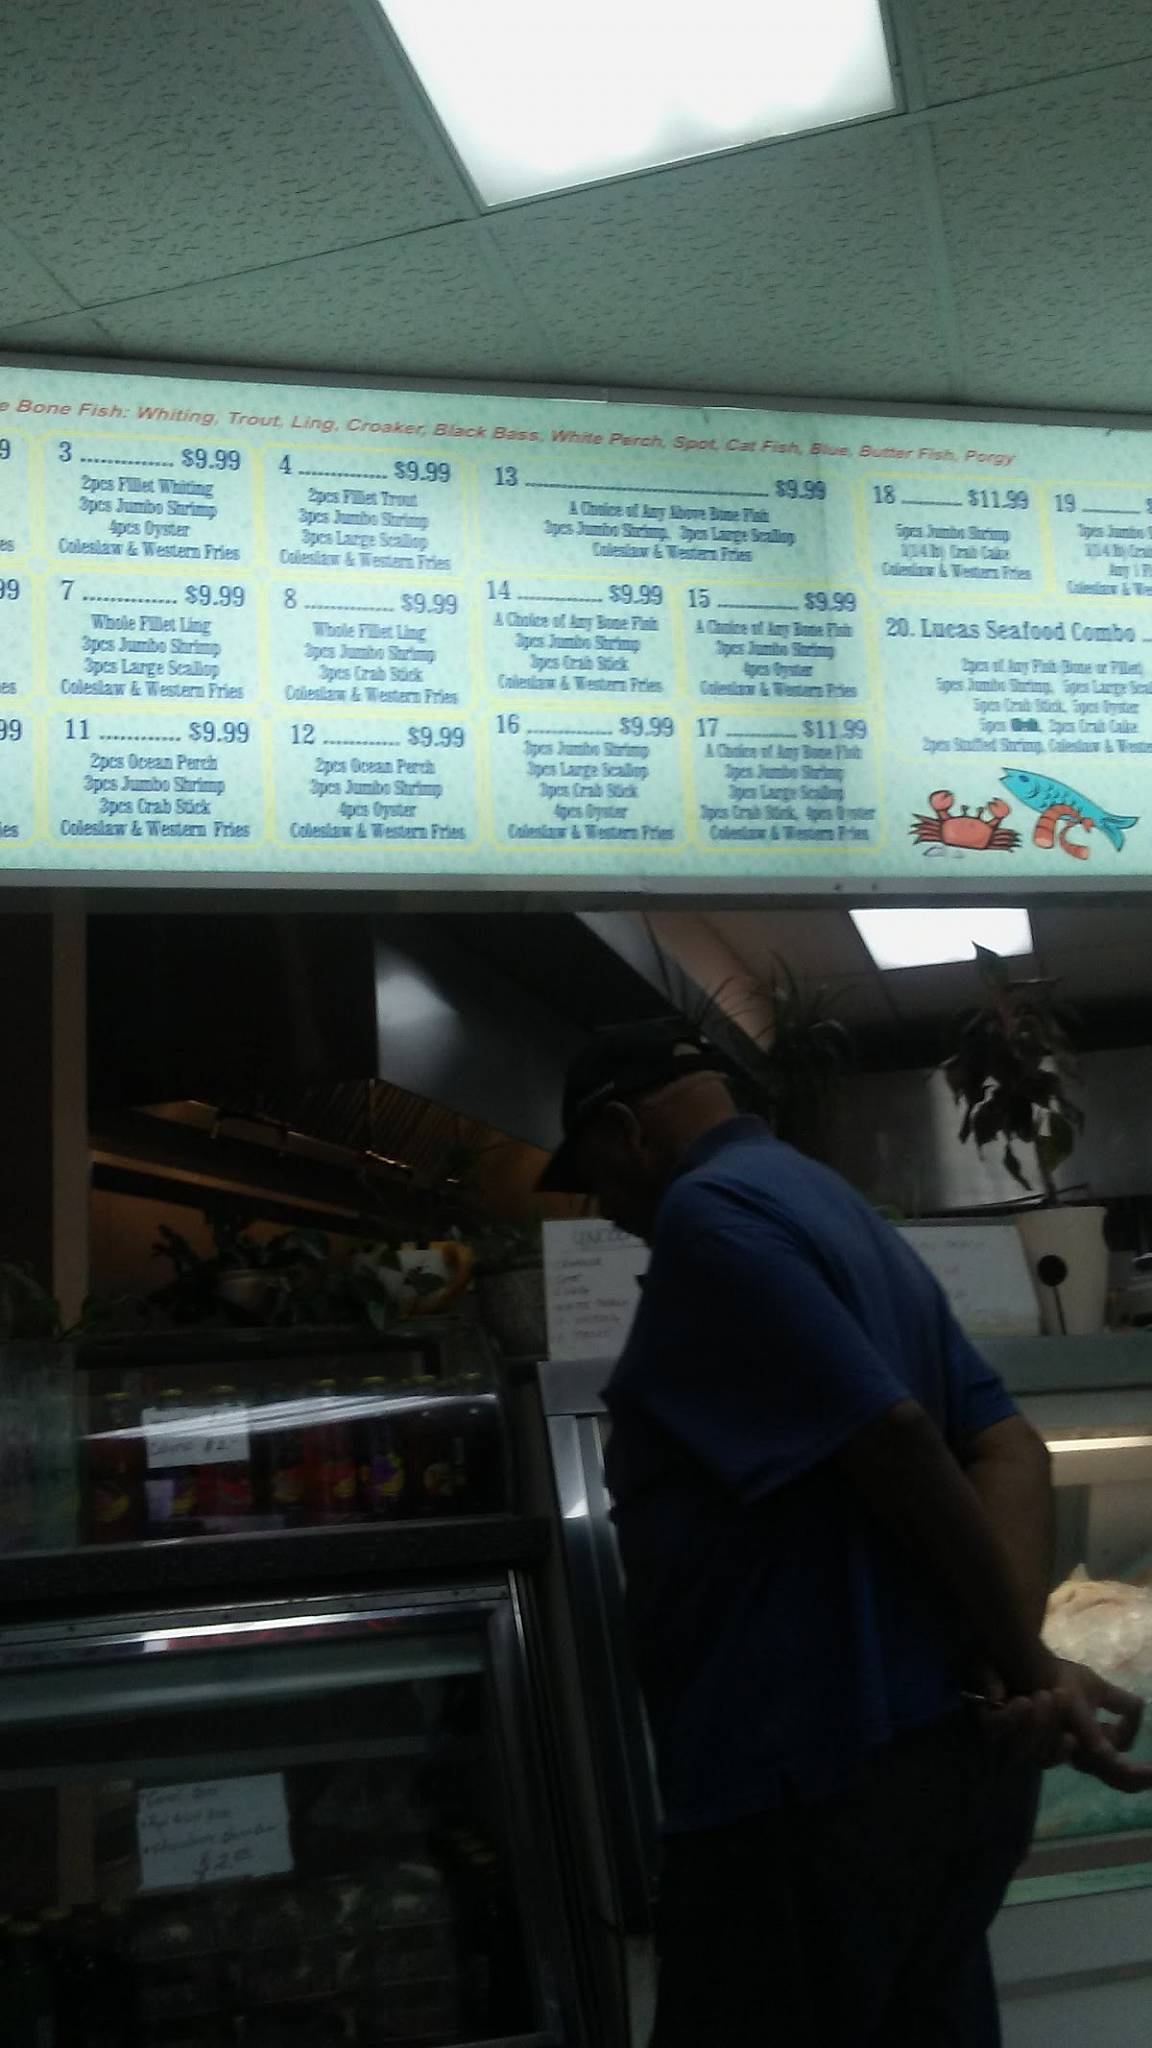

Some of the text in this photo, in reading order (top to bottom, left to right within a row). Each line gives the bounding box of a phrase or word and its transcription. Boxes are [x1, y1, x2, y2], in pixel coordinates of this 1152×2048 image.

[16, 400, 71, 415] Bone
[78, 404, 129, 418] Fish:
[433, 424, 486, 439] Black
[552, 430, 602, 445] White
[725, 439, 756, 452] Cat
[859, 445, 913, 458] Butter
[965, 450, 1016, 466] Porgy
[59, 442, 241, 470] 3 $9.99
[279, 455, 450, 482] 4 $9.99
[495, 466, 826, 500] 13 $9.99
[873, 485, 1028, 509] 18 $11.99
[1055, 494, 1075, 512] 19
[110, 520, 189, 538] 4pcs Oyster
[59, 538, 240, 560] Coleslaw & Western Fries
[279, 550, 450, 570] Coleslaw & Western Fries
[61, 580, 245, 607] 7 $9.99
[284, 588, 458, 615] 8 $9.99
[487, 580, 663, 605] 14 $9.99
[688, 588, 856, 612] 15 $9.99
[91, 614, 211, 635] Whole Fillet Ling
[886, 618, 1136, 642] 20. Lucas Seafood Combo
[120, 637, 167, 653] Jumbo
[170, 638, 221, 657] Shrimp
[122, 659, 164, 678] Large
[169, 660, 220, 679] Scallop
[61, 679, 245, 699] Coleslaw & Western Fries
[285, 685, 459, 704] Coleslaw & Western Fries
[65, 719, 249, 743] 11 $9.99
[291, 724, 465, 748] 12 $9.99
[497, 714, 674, 737] 16 $9.99
[697, 718, 867, 740] 17 $11.99
[90, 753, 217, 771] 2pcs Ocean Perch
[315, 757, 435, 776] 2pcs Ocean Perch
[121, 776, 169, 792] Jumbo
[174, 777, 225, 795] Shrimp
[137, 799, 171, 814] Crab
[175, 800, 211, 815] Stick
[61, 820, 250, 838] Coleslaw & Western Fries
[290, 823, 466, 839] Coleslaw & Western Fries
